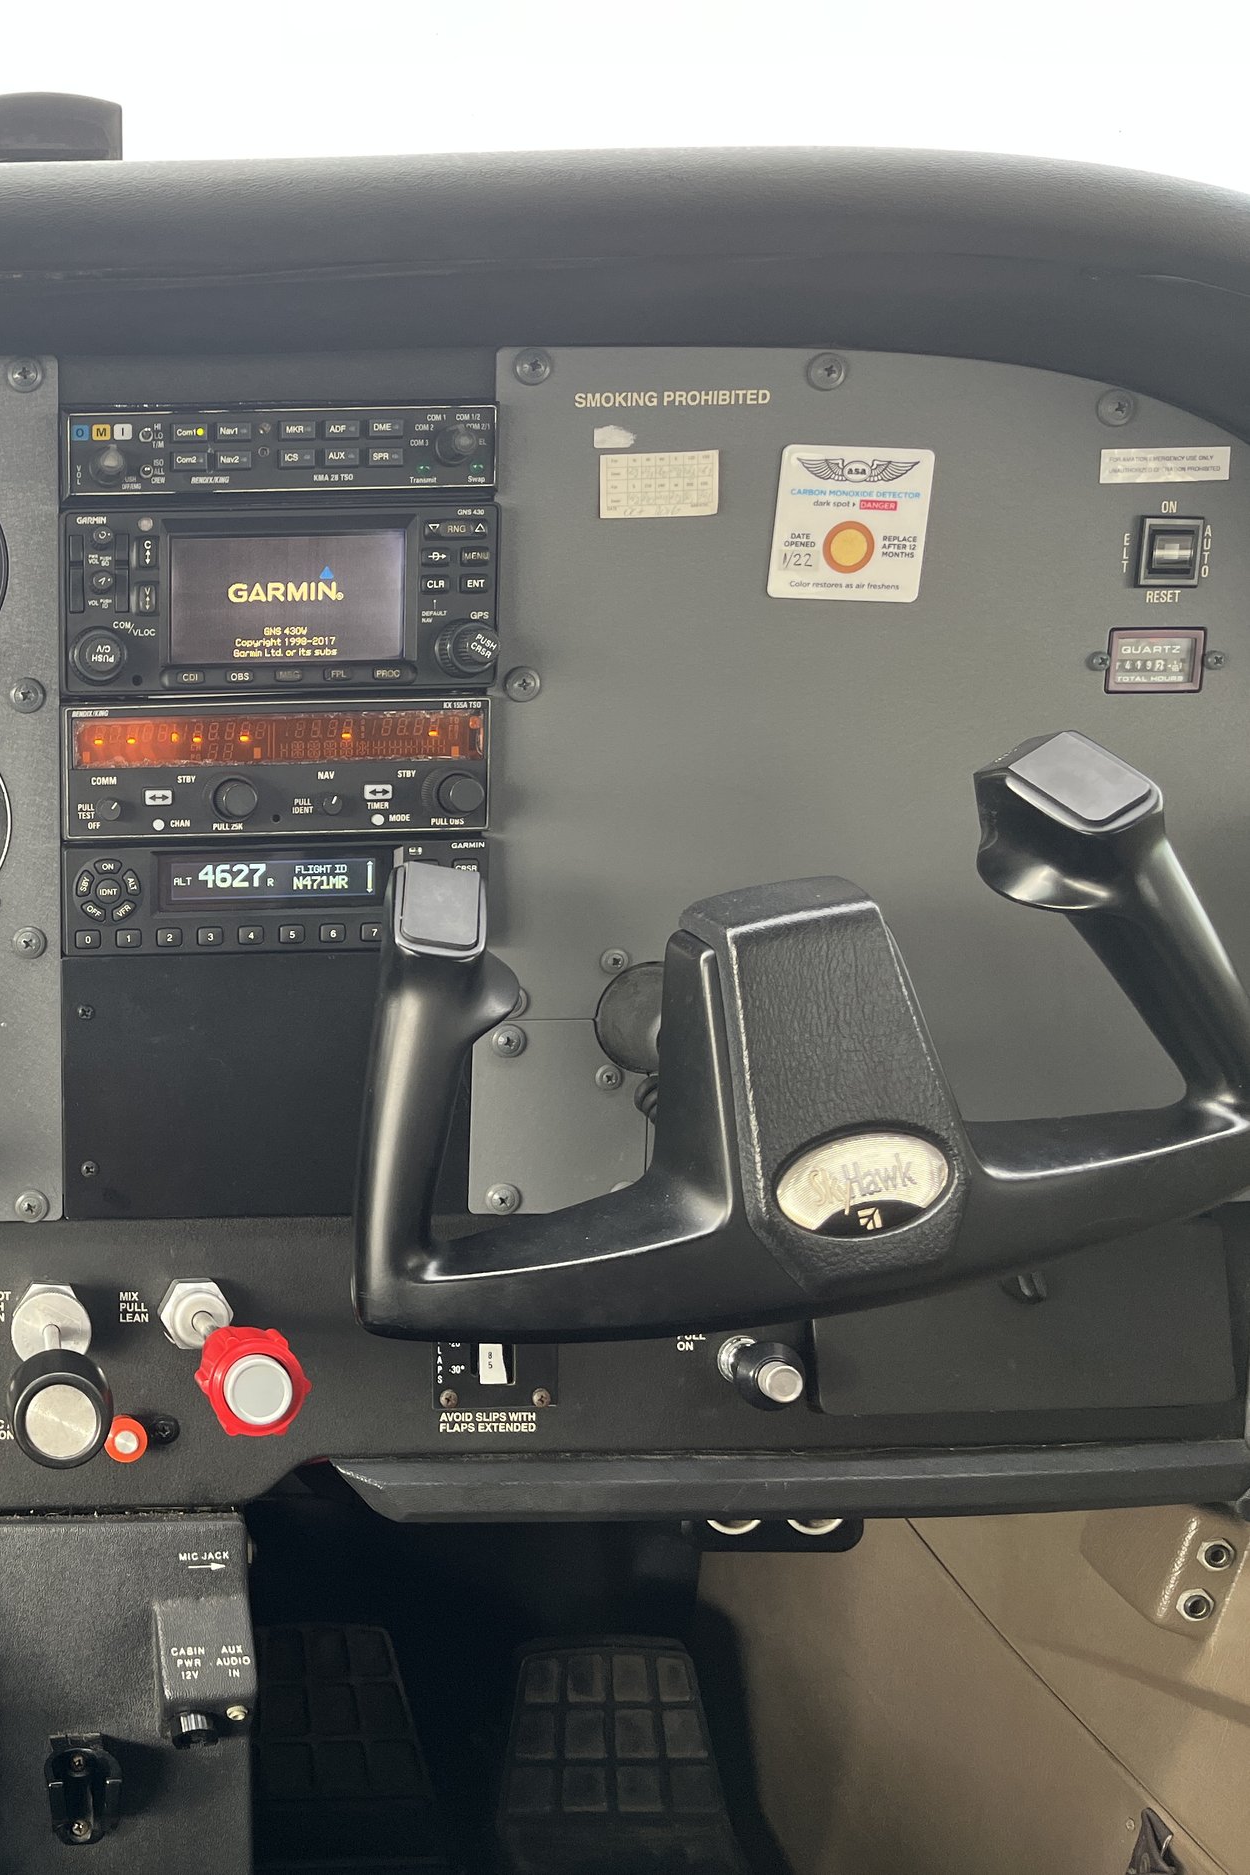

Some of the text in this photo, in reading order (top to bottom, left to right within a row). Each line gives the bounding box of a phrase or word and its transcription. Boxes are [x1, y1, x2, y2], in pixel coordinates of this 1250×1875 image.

[575, 390, 770, 408] SMOKING PROHIBITED
[1162, 501, 1177, 513] ON
[1146, 591, 1180, 602] RESET
[264, 627, 307, 636] GNS 430W
[236, 637, 335, 647] Copyright 1998-2017
[234, 649, 262, 657] Garmin
[265, 649, 283, 657] Ltd.
[299, 648, 311, 656] its
[183, 673, 198, 681] CDI
[398, 770, 416, 778] STBY
[91, 777, 116, 785] COMM
[296, 865, 347, 874] FLIGHT ID
[199, 864, 266, 888] 4627
[293, 876, 348, 889] N471MR
[119, 1292, 138, 1301] MIX
[120, 1303, 147, 1312] PULL
[120, 1314, 149, 1323] LEAN
[439, 1412, 536, 1422] AVOID SLIPS WITH
[439, 1423, 536, 1433] FLAPS EXTENDED
[179, 1551, 229, 1560] MIC JACK
[171, 1646, 205, 1656] CABIN
[221, 1645, 243, 1654] AUX
[177, 1658, 200, 1667] PWR
[216, 1656, 250, 1666] AUDIO
[181, 1670, 199, 1679] 12V
[228, 1669, 239, 1677] IN
